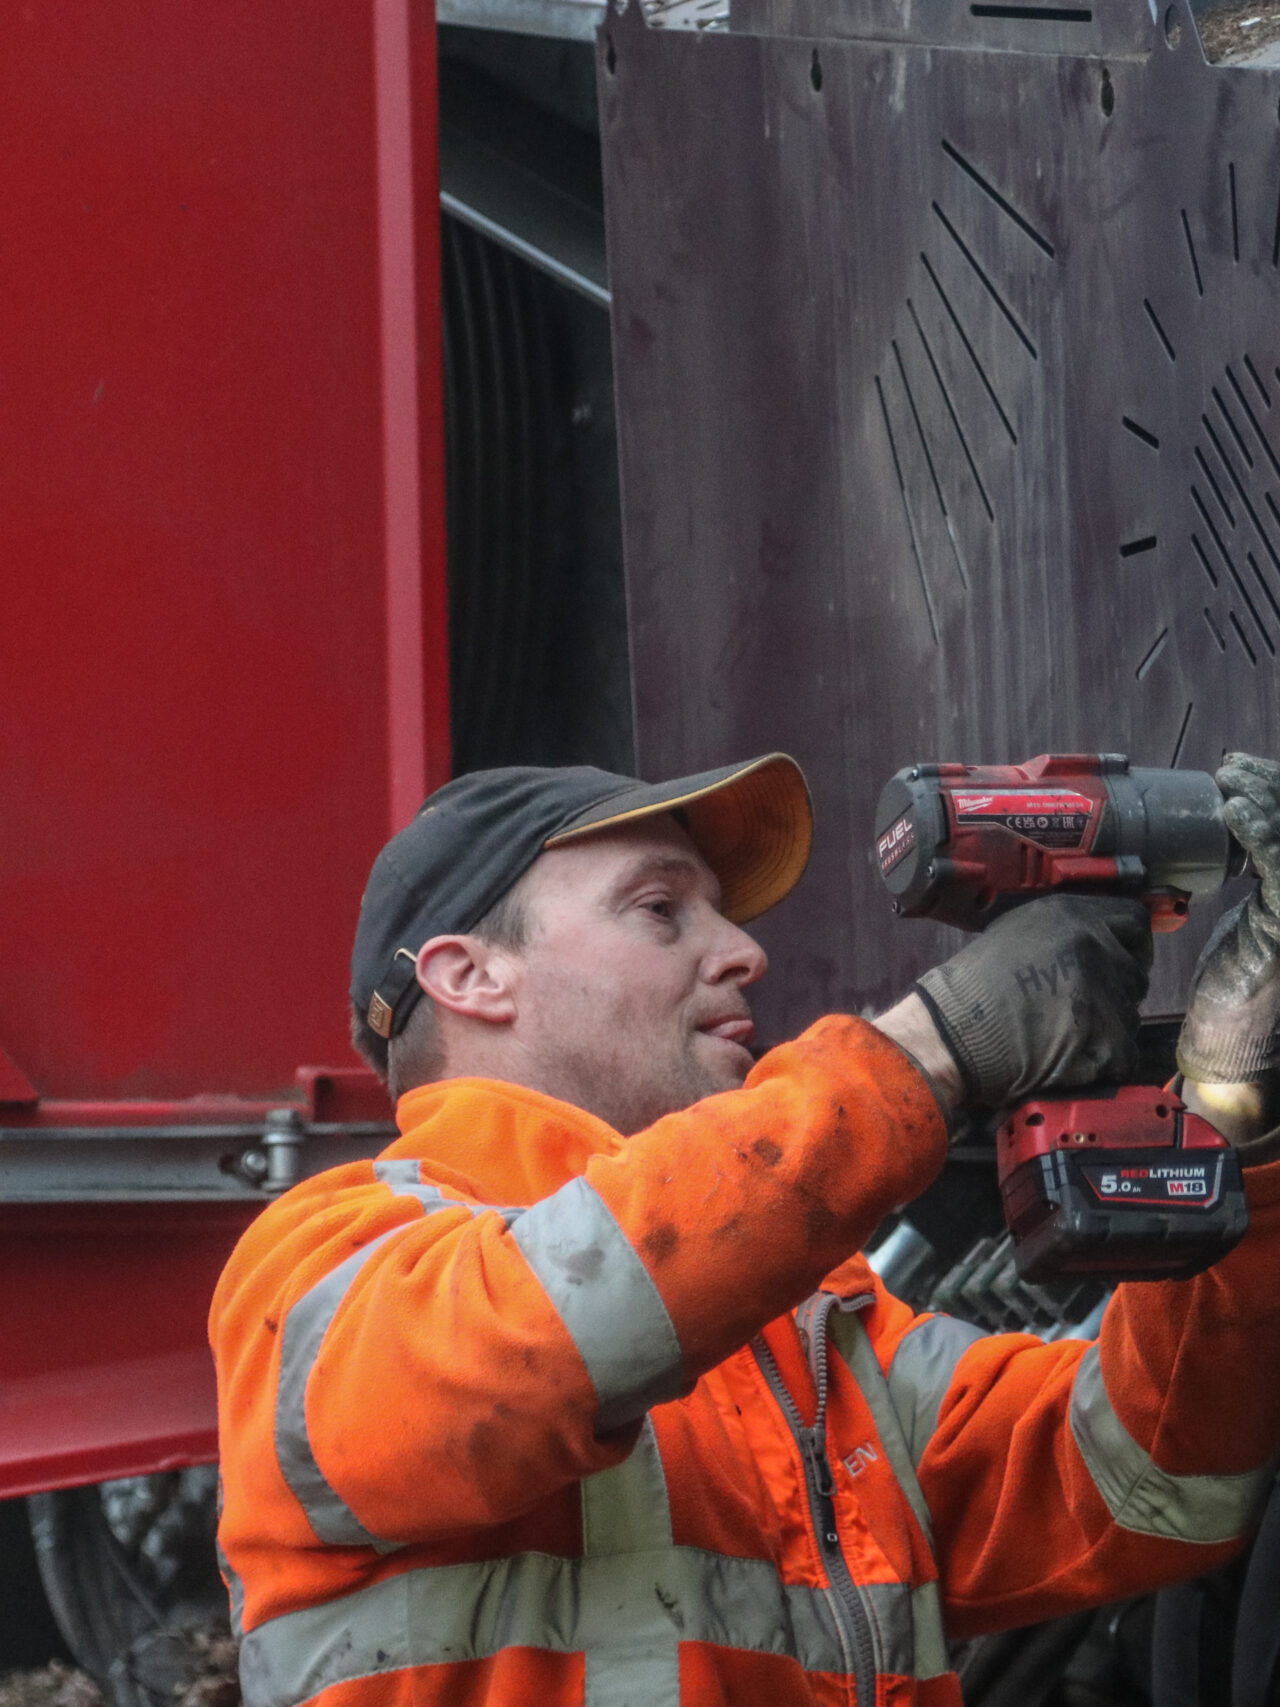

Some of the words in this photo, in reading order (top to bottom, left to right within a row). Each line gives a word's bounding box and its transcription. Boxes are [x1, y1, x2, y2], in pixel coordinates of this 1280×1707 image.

[879, 819, 912, 858] FUEL
[1120, 1168, 1205, 1179] REDLITHIUM
[1101, 1174, 1131, 1194] 5.0
[1168, 1181, 1205, 1194] M18
